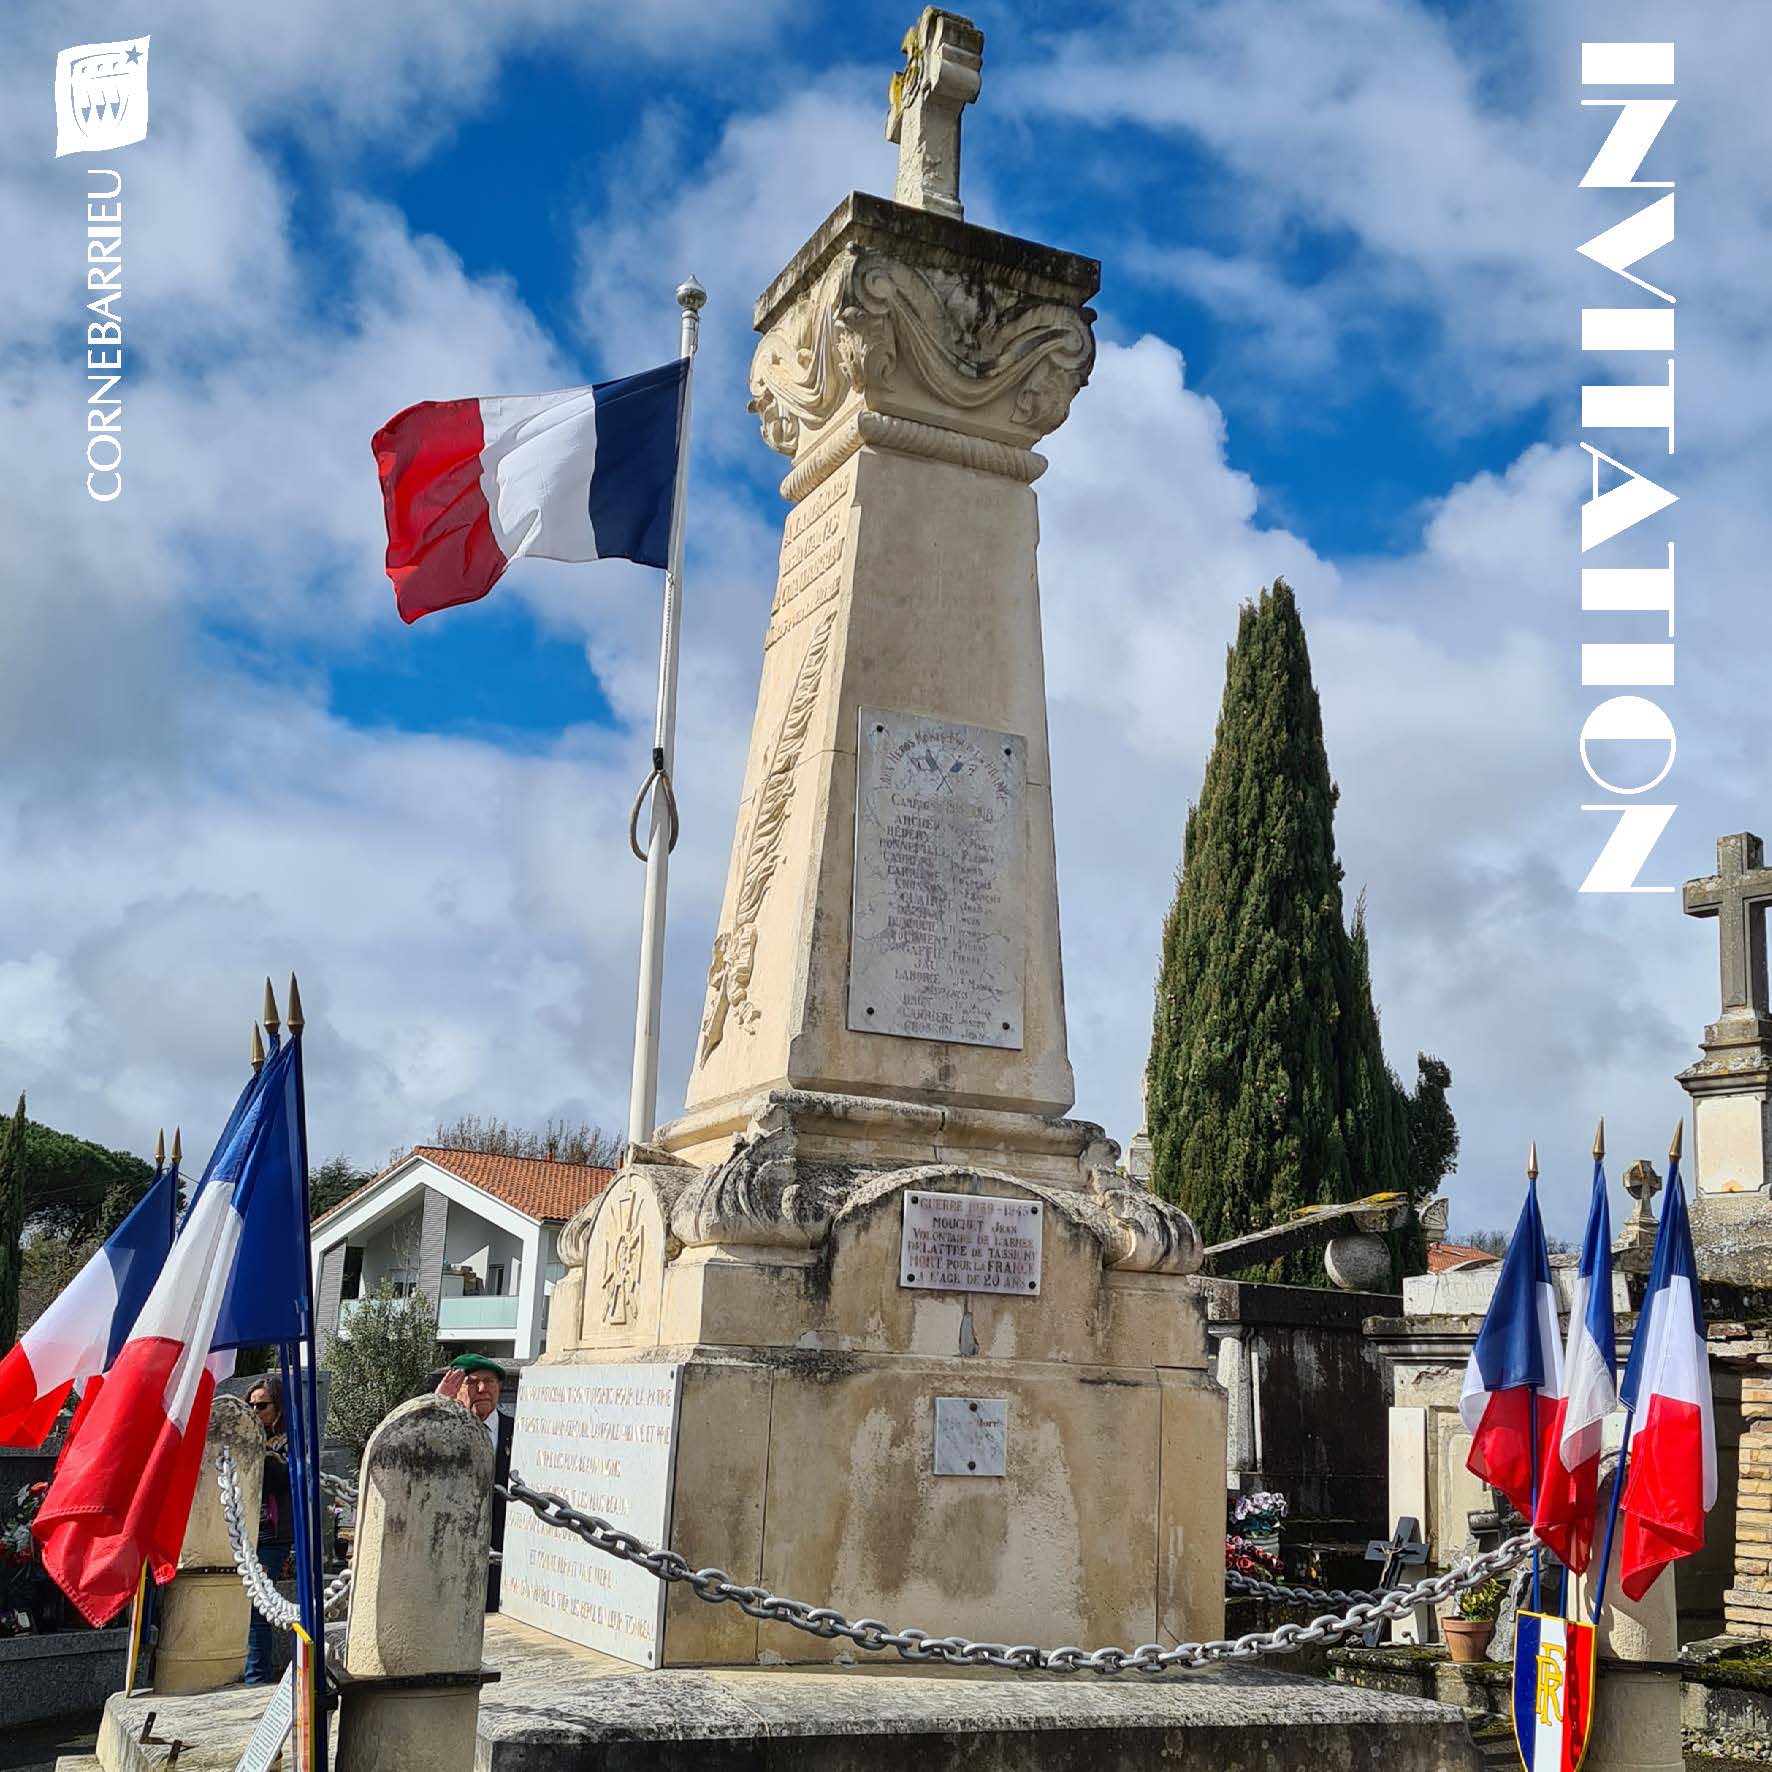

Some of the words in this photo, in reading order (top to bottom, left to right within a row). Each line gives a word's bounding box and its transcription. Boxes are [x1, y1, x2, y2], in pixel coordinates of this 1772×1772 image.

[920, 1197, 963, 1213] GUERRE
[946, 1258, 972, 1271] POUR
[987, 1260, 1036, 1275] FRANCE
[967, 1274, 982, 1287] DE
[983, 1272, 1000, 1287] 20
